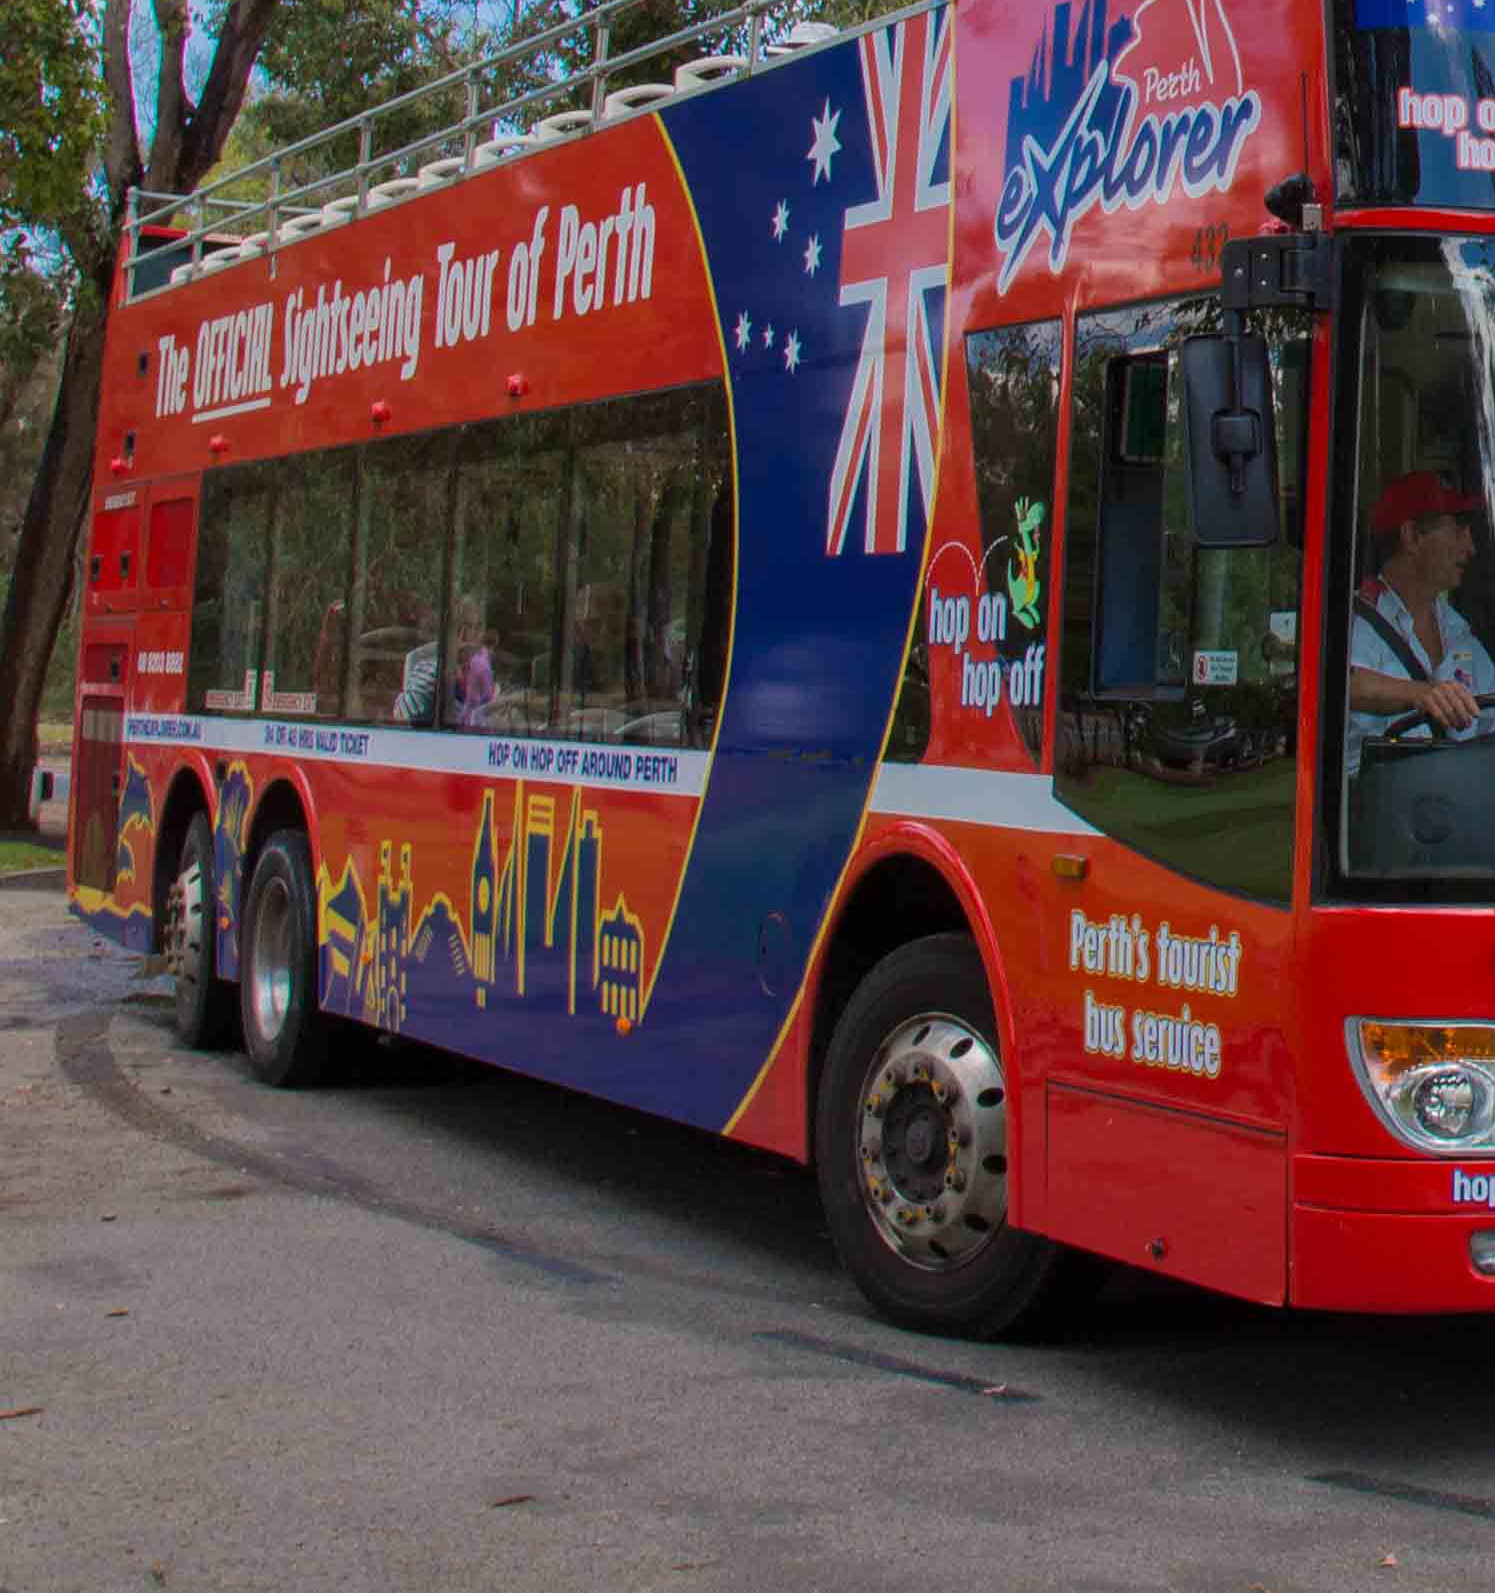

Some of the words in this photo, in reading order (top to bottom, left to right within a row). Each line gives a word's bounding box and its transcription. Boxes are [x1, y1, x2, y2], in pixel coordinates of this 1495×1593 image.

[1144, 65, 1201, 102] Perth
[1400, 88, 1465, 136] hop
[156, 336, 189, 418] The
[193, 303, 273, 410] OFFICIAL
[280, 259, 424, 404] Sightseeing
[435, 243, 499, 347] Tour
[506, 206, 548, 332] of
[552, 183, 655, 320] Perth
[928, 587, 969, 654] hop
[977, 590, 1007, 641] on
[961, 650, 1001, 718] hop
[1008, 643, 1045, 708] off
[341, 733, 369, 756] TICKET
[489, 742, 510, 766] HOP
[512, 744, 528, 768] ON
[530, 746, 553, 771] HOP
[557, 748, 579, 775] OFF
[582, 750, 631, 780] AROUND
[636, 755, 678, 783] PERTH
[1070, 908, 1150, 984] Perth's
[1156, 920, 1242, 998] tourist
[1083, 990, 1125, 1055] bus
[1131, 1004, 1222, 1080] service
